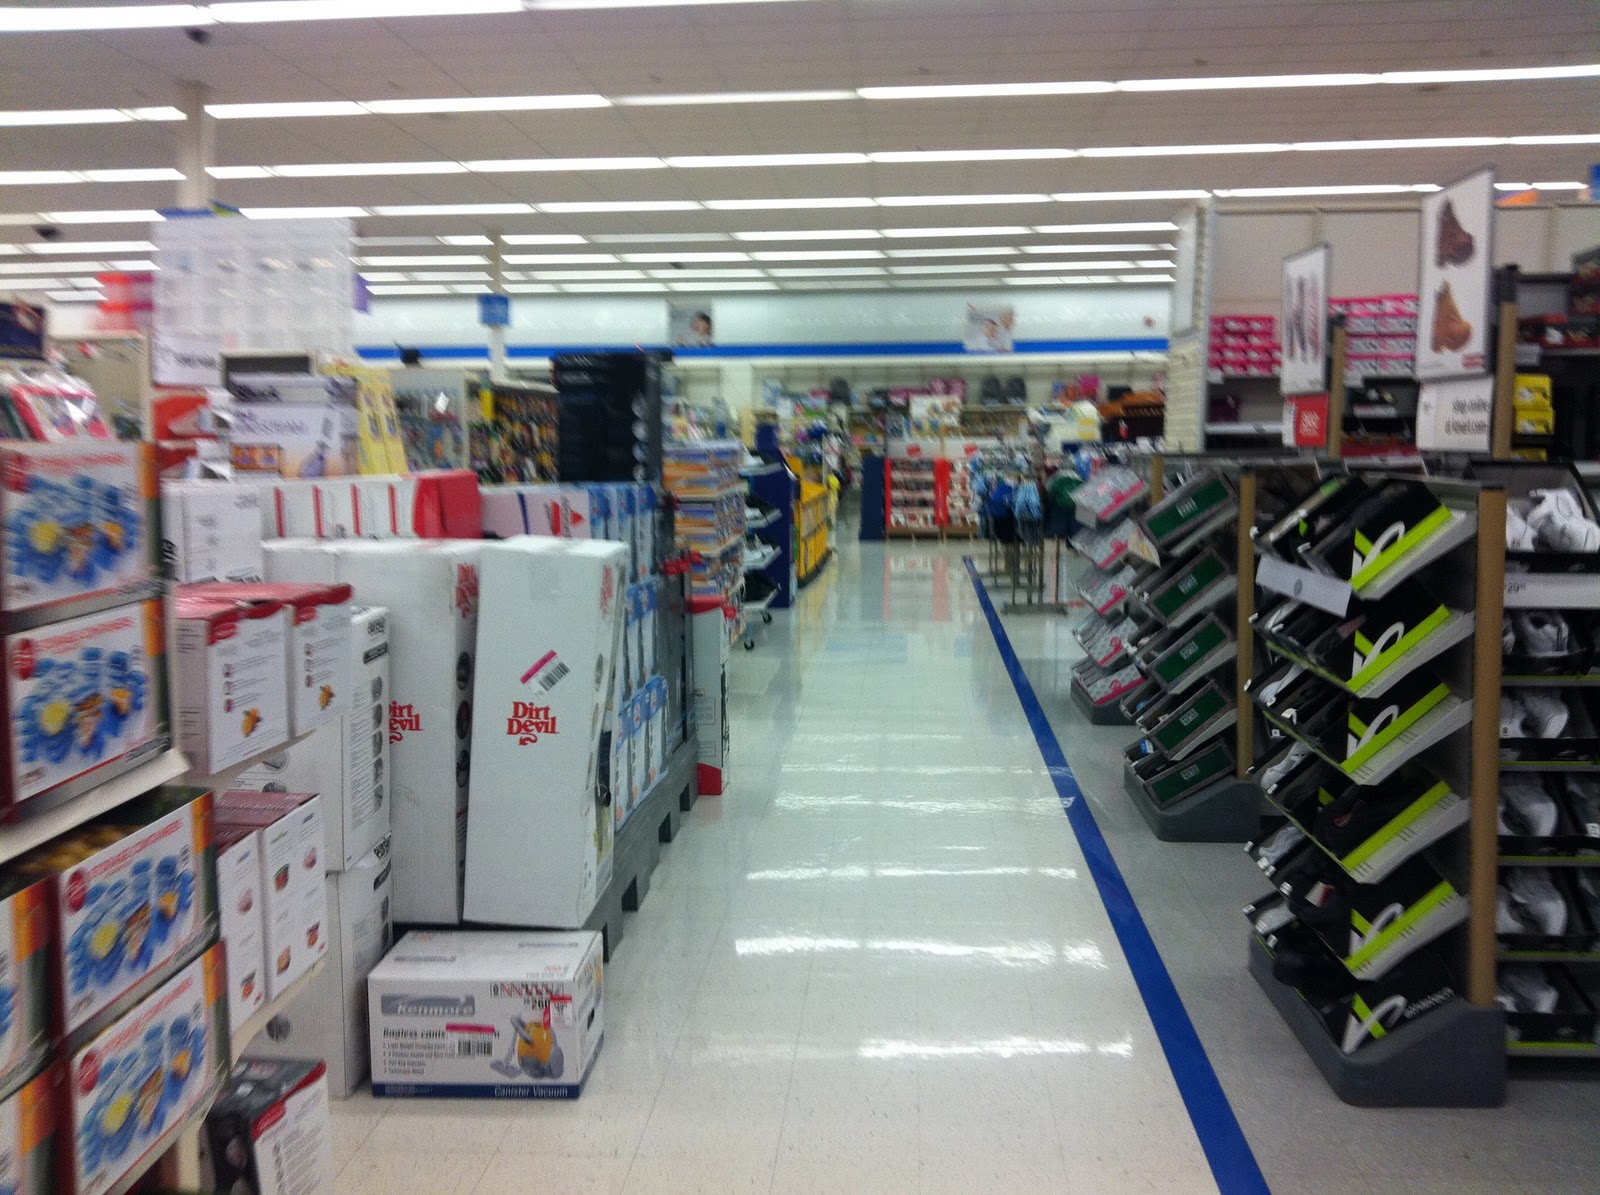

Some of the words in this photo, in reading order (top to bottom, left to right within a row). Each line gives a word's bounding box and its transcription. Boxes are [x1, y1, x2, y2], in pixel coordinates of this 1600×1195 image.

[389, 700, 413, 718] irt
[512, 701, 551, 720] Dirt
[389, 714, 424, 732] evil
[506, 716, 559, 735] Devil
[532, 1085, 569, 1098] Vacuum
